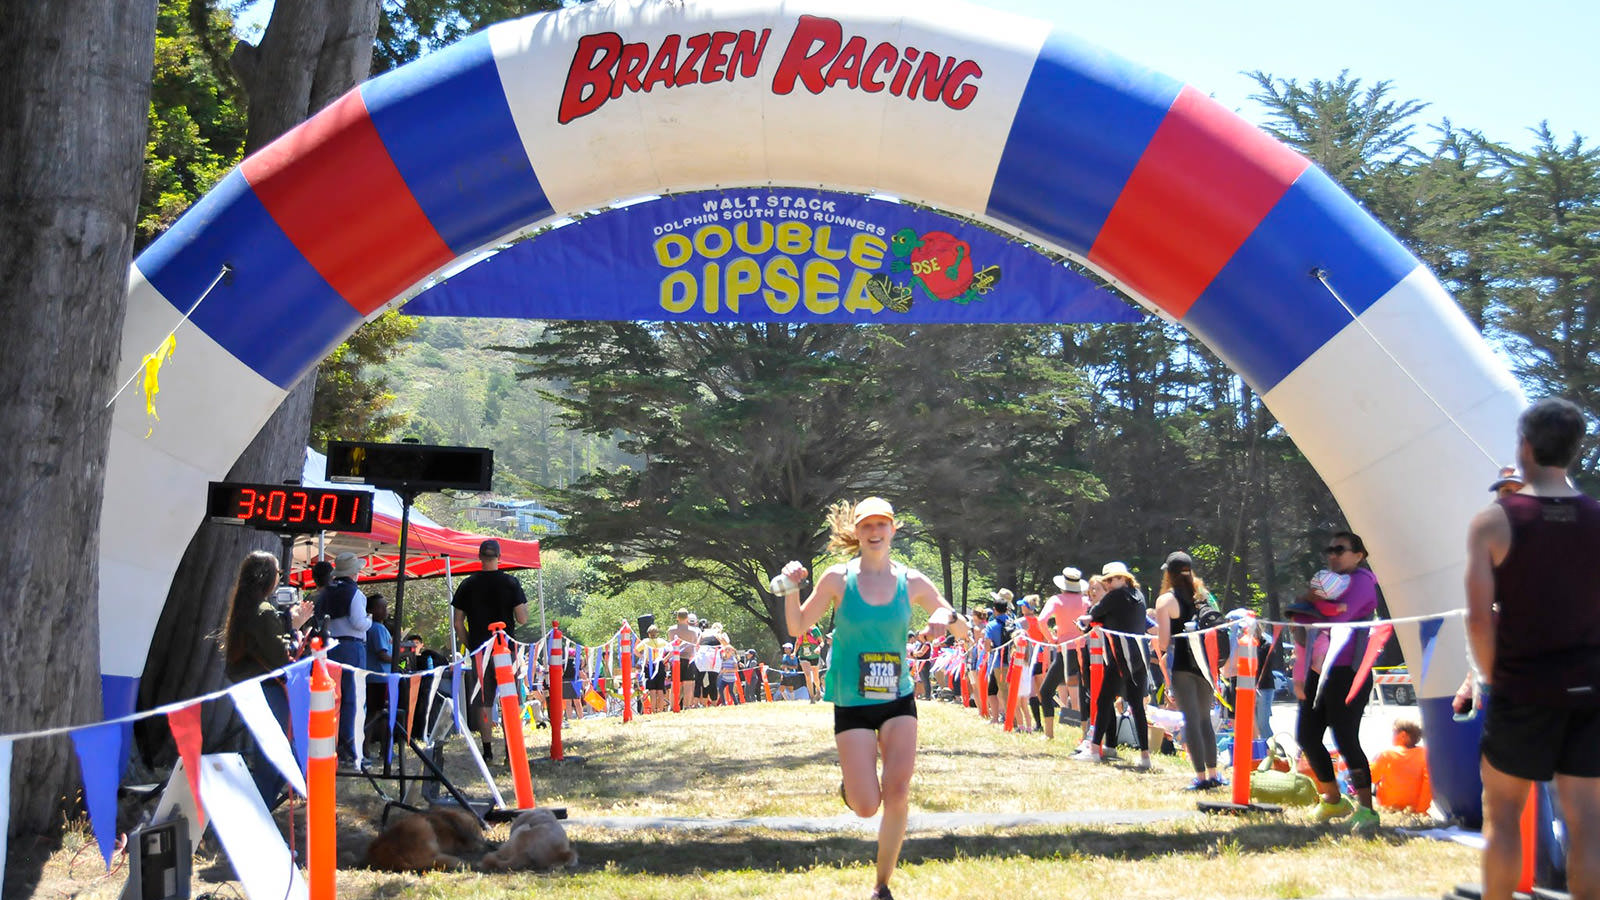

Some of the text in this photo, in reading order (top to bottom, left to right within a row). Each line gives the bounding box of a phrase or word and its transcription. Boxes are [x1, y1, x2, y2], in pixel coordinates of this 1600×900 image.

[557, 29, 772, 125] BRAZEN
[653, 208, 887, 237] DOLPHIN SOUTH END RUNNERS
[702, 196, 838, 213] WALT STACK
[653, 221, 888, 270] DOUBLE
[659, 256, 885, 315] DIPSEA
[912, 257, 941, 275] DSE
